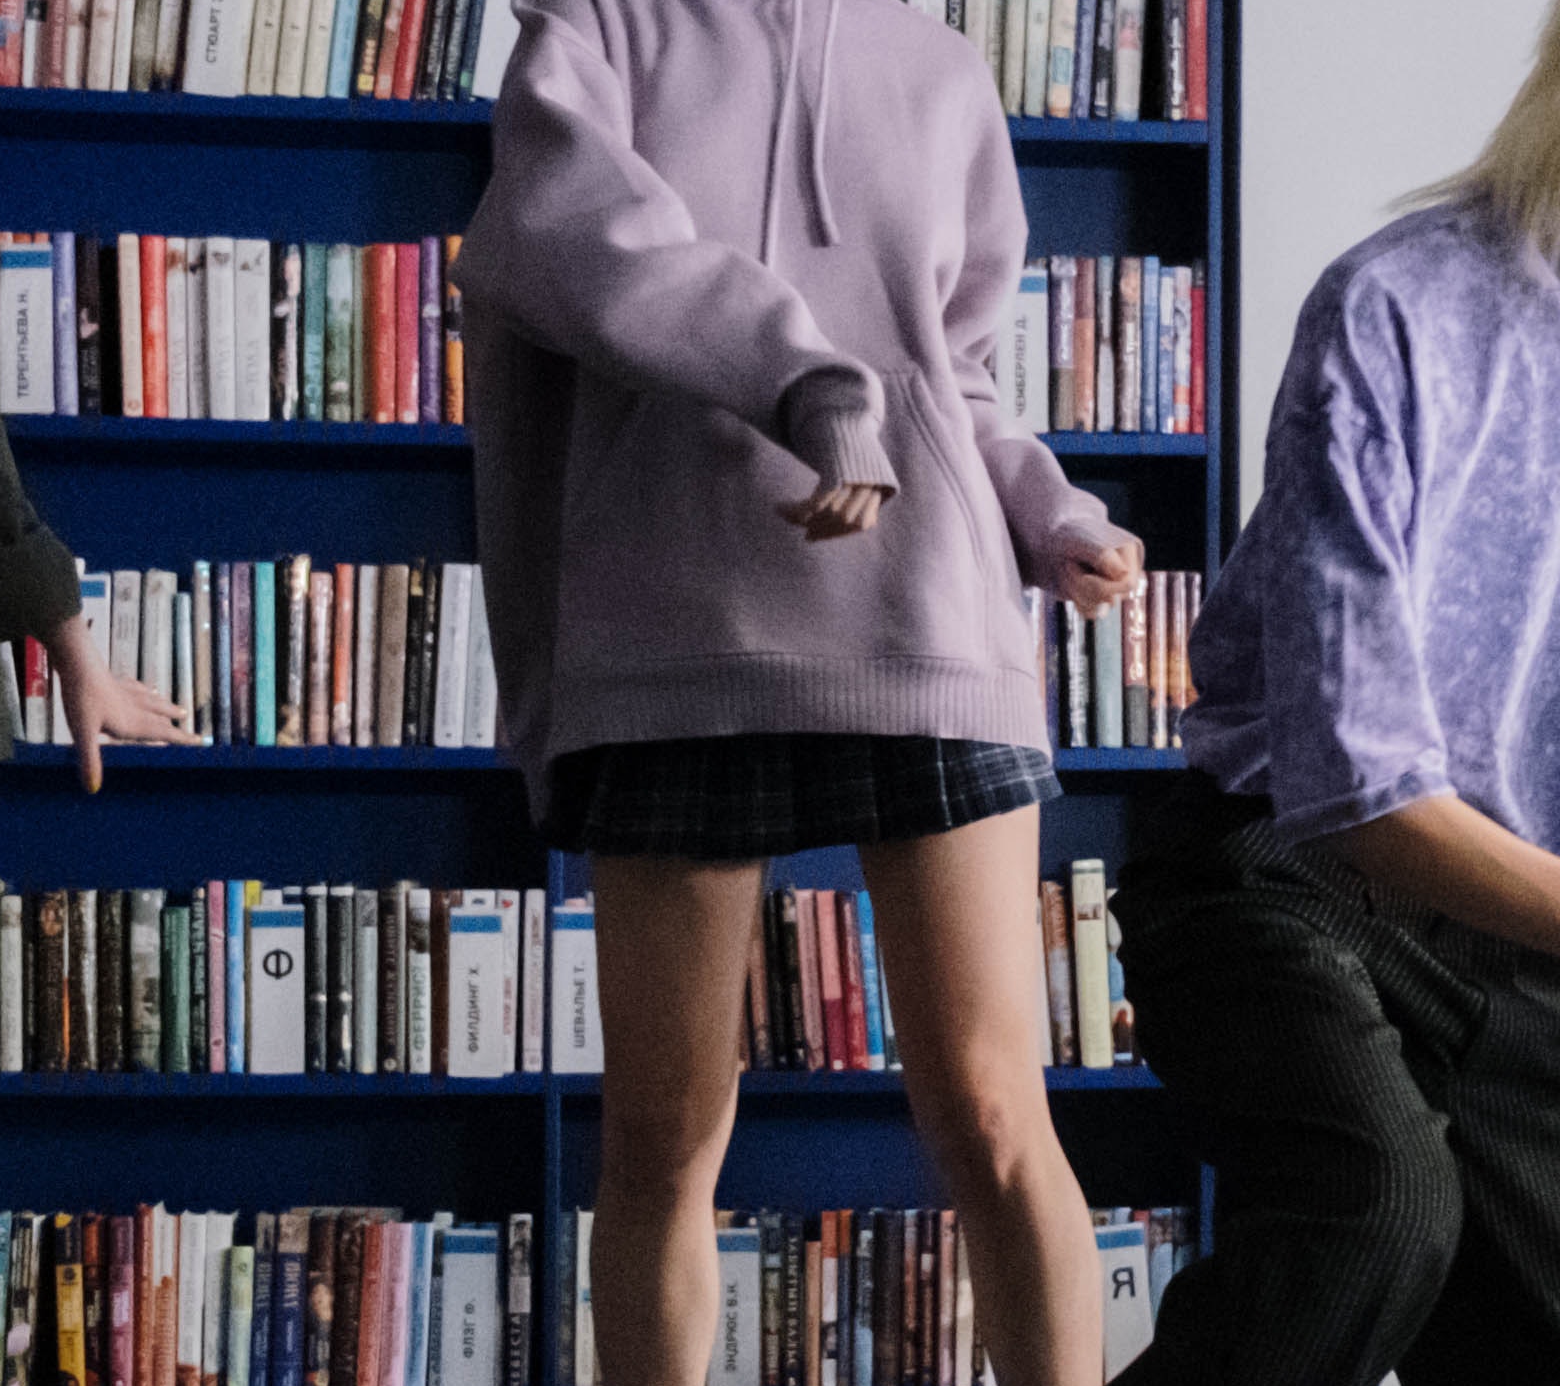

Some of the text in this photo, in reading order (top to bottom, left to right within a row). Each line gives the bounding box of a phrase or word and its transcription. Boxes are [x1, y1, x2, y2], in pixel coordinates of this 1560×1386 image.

[203, 8, 223, 65] СТЮАРТ
[15, 307, 30, 399] ТЕРЕНТЬЕВА
[1013, 333, 1028, 419] ЧЕМБЕРЛЕН
[261, 948, 294, 980] Ф
[467, 980, 482, 1054] ФИЛДИНГ
[572, 979, 586, 1049] ШЕВАЛЬЕ
[1110, 1265, 1137, 1300] Я
[724, 1312, 738, 1374] ЭНДРЮС
